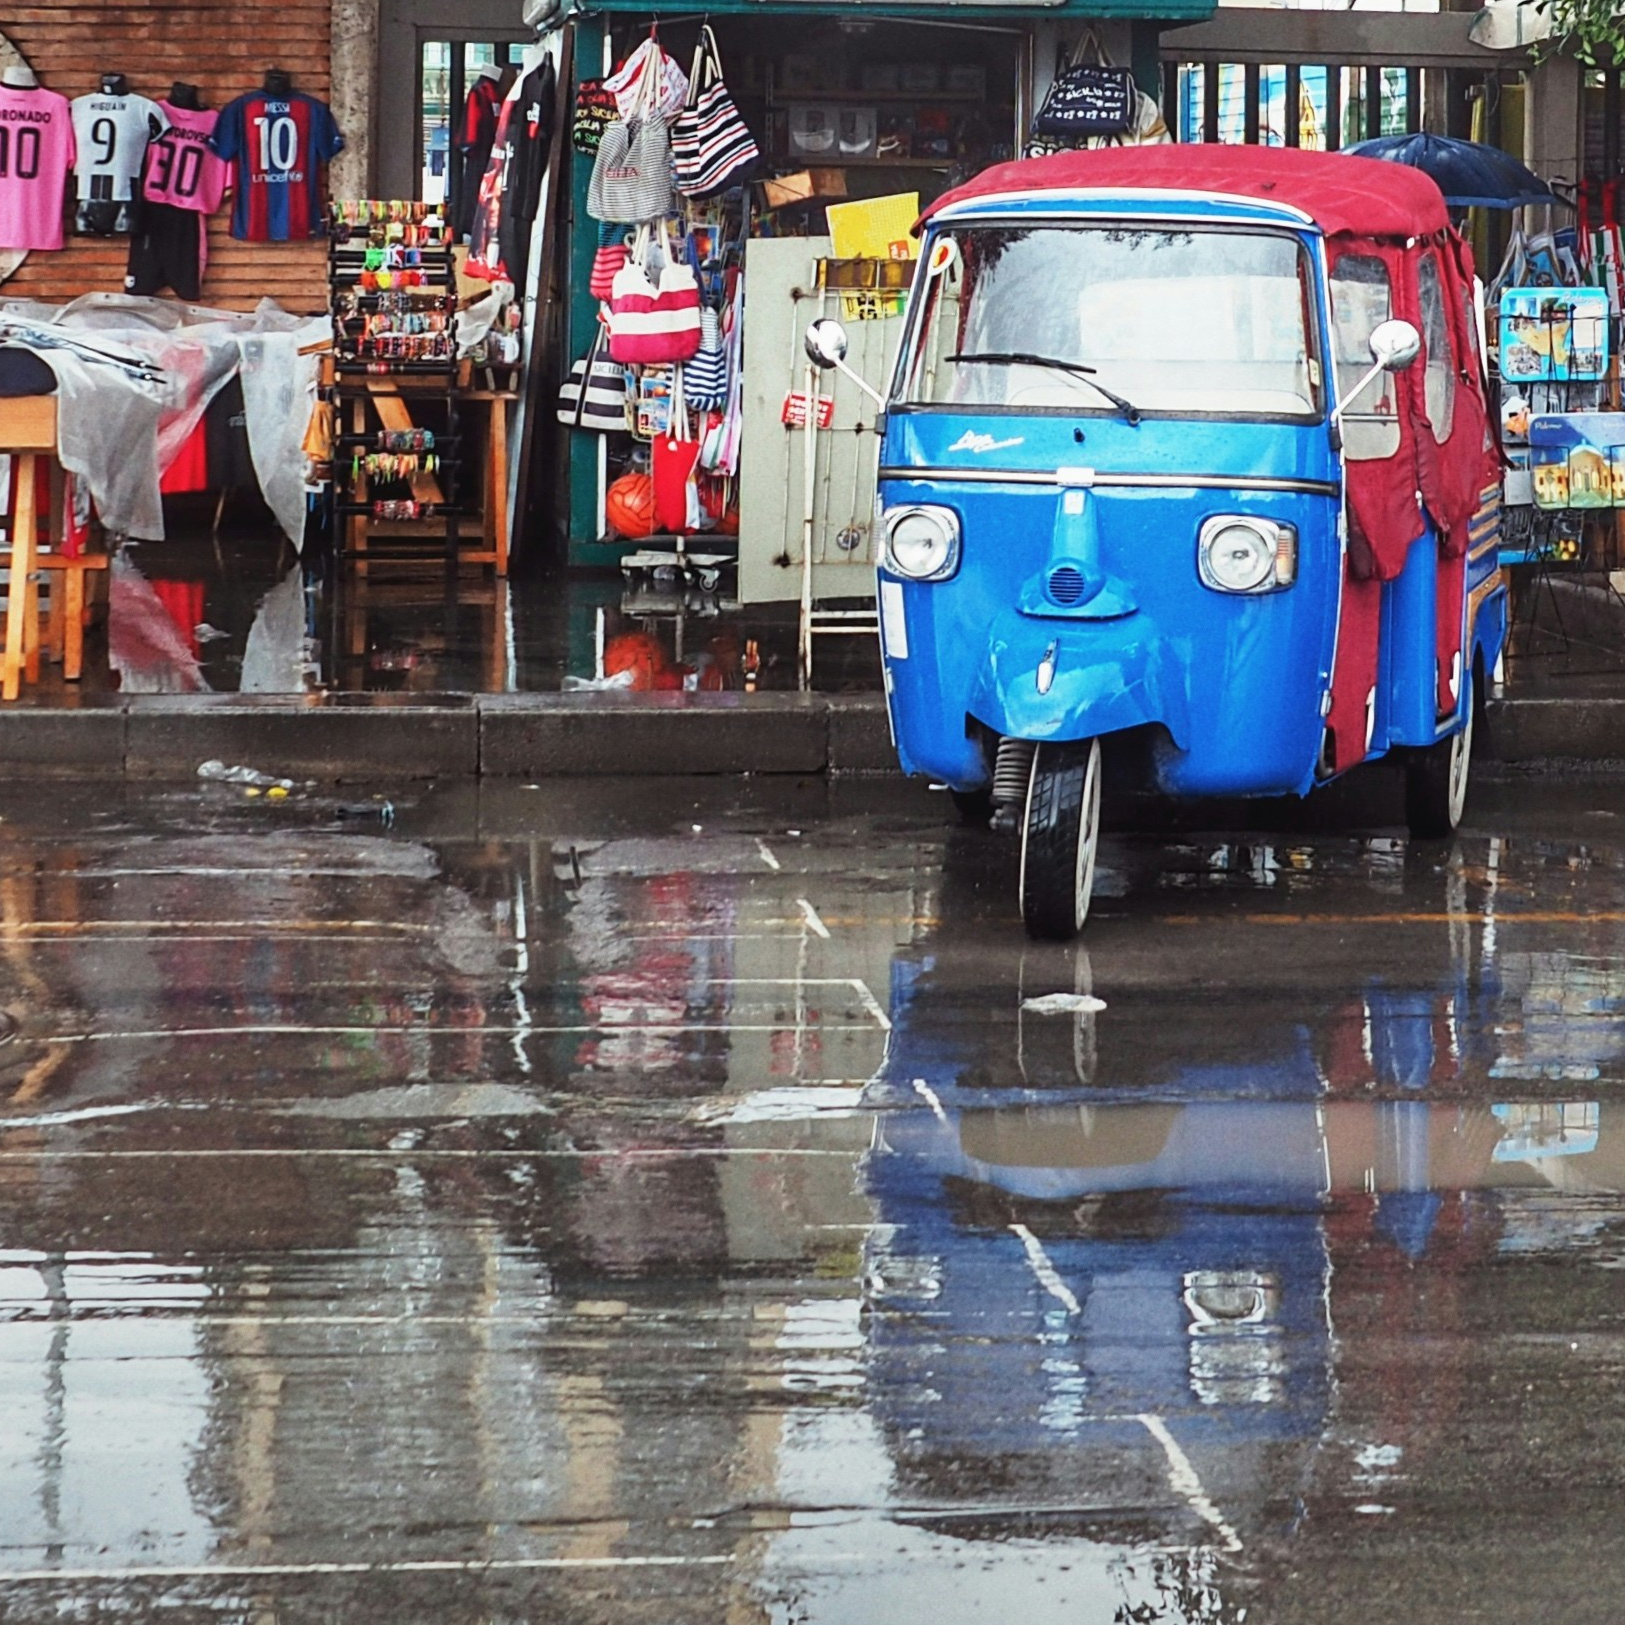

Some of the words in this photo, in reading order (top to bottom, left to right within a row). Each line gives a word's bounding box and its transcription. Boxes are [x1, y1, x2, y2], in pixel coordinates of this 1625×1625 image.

[264, 102, 290, 113] MESSI
[91, 118, 117, 165] 9
[254, 117, 298, 170] 10
[150, 140, 204, 198] 30
